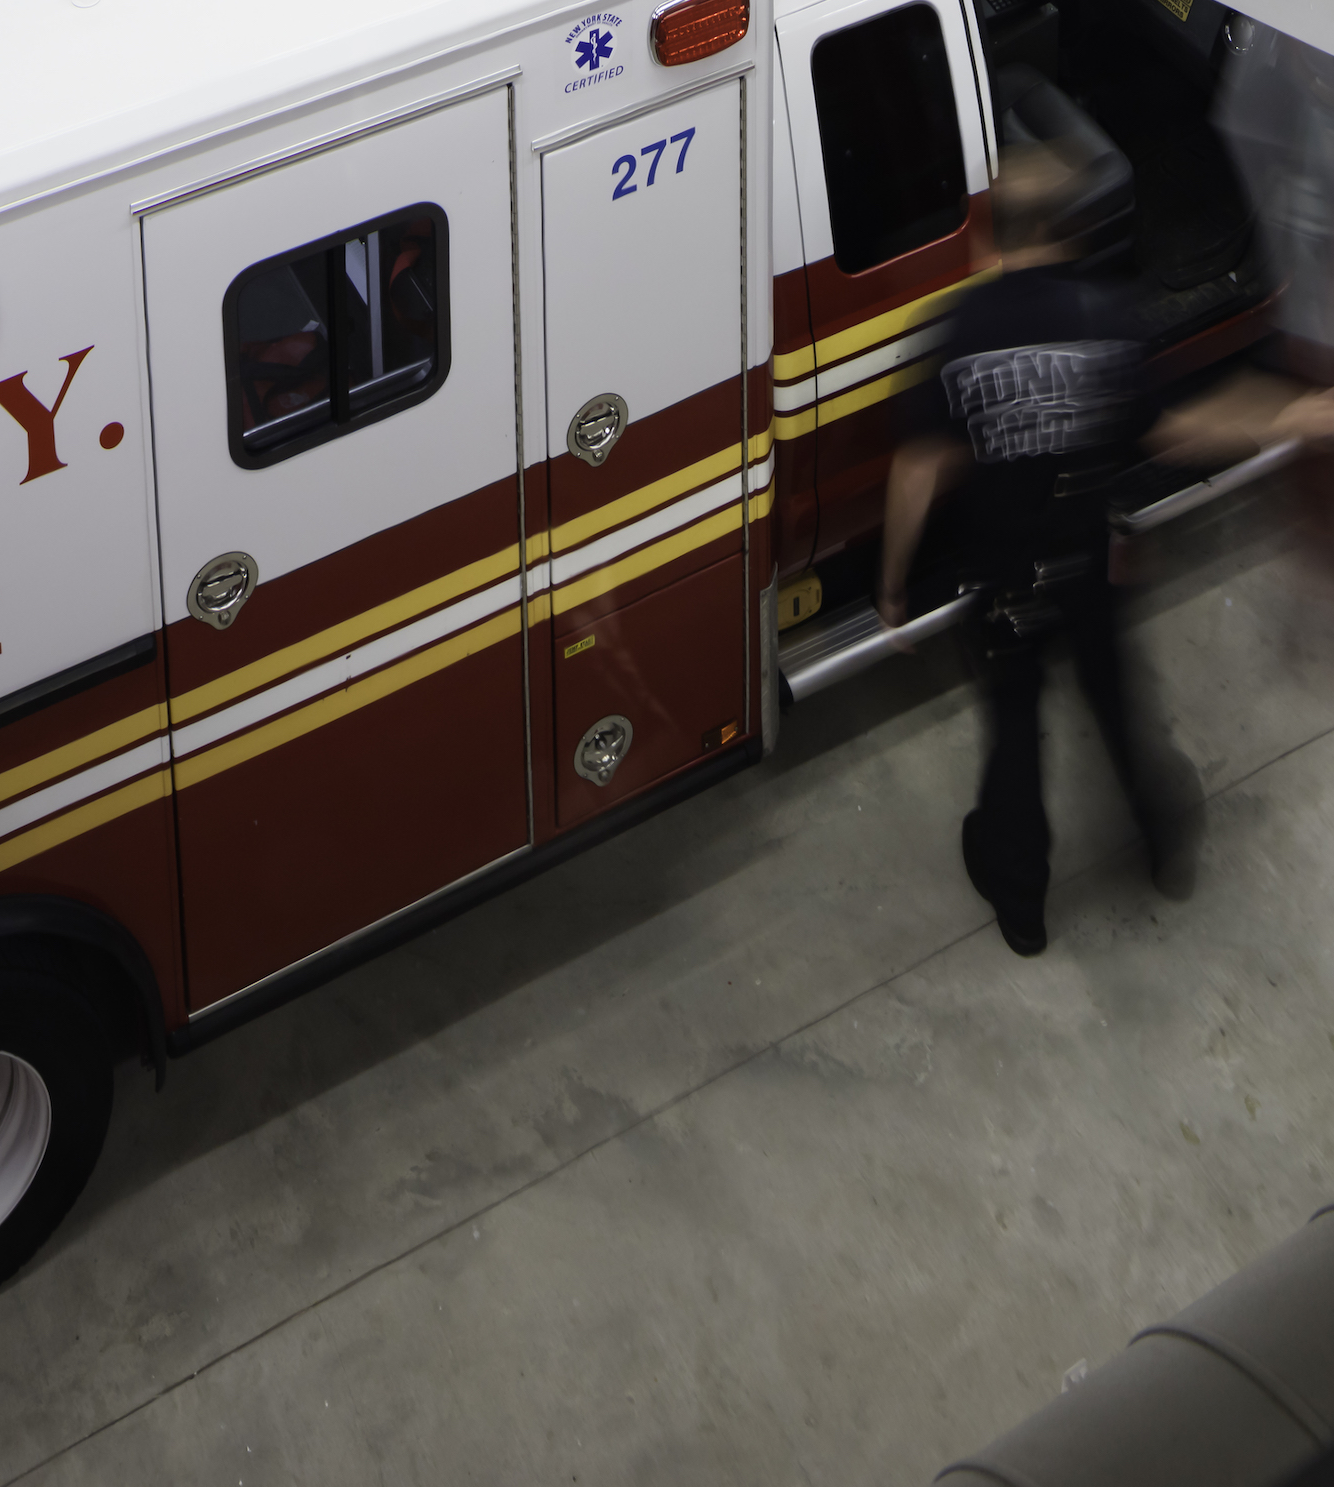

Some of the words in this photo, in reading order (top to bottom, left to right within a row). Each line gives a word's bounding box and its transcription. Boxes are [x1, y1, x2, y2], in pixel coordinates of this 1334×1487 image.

[565, 24, 582, 44] NEW
[581, 13, 602, 27] YORK
[602, 13, 623, 27] STATE
[564, 65, 624, 94] CERTIFIED
[611, 126, 696, 202] 277
